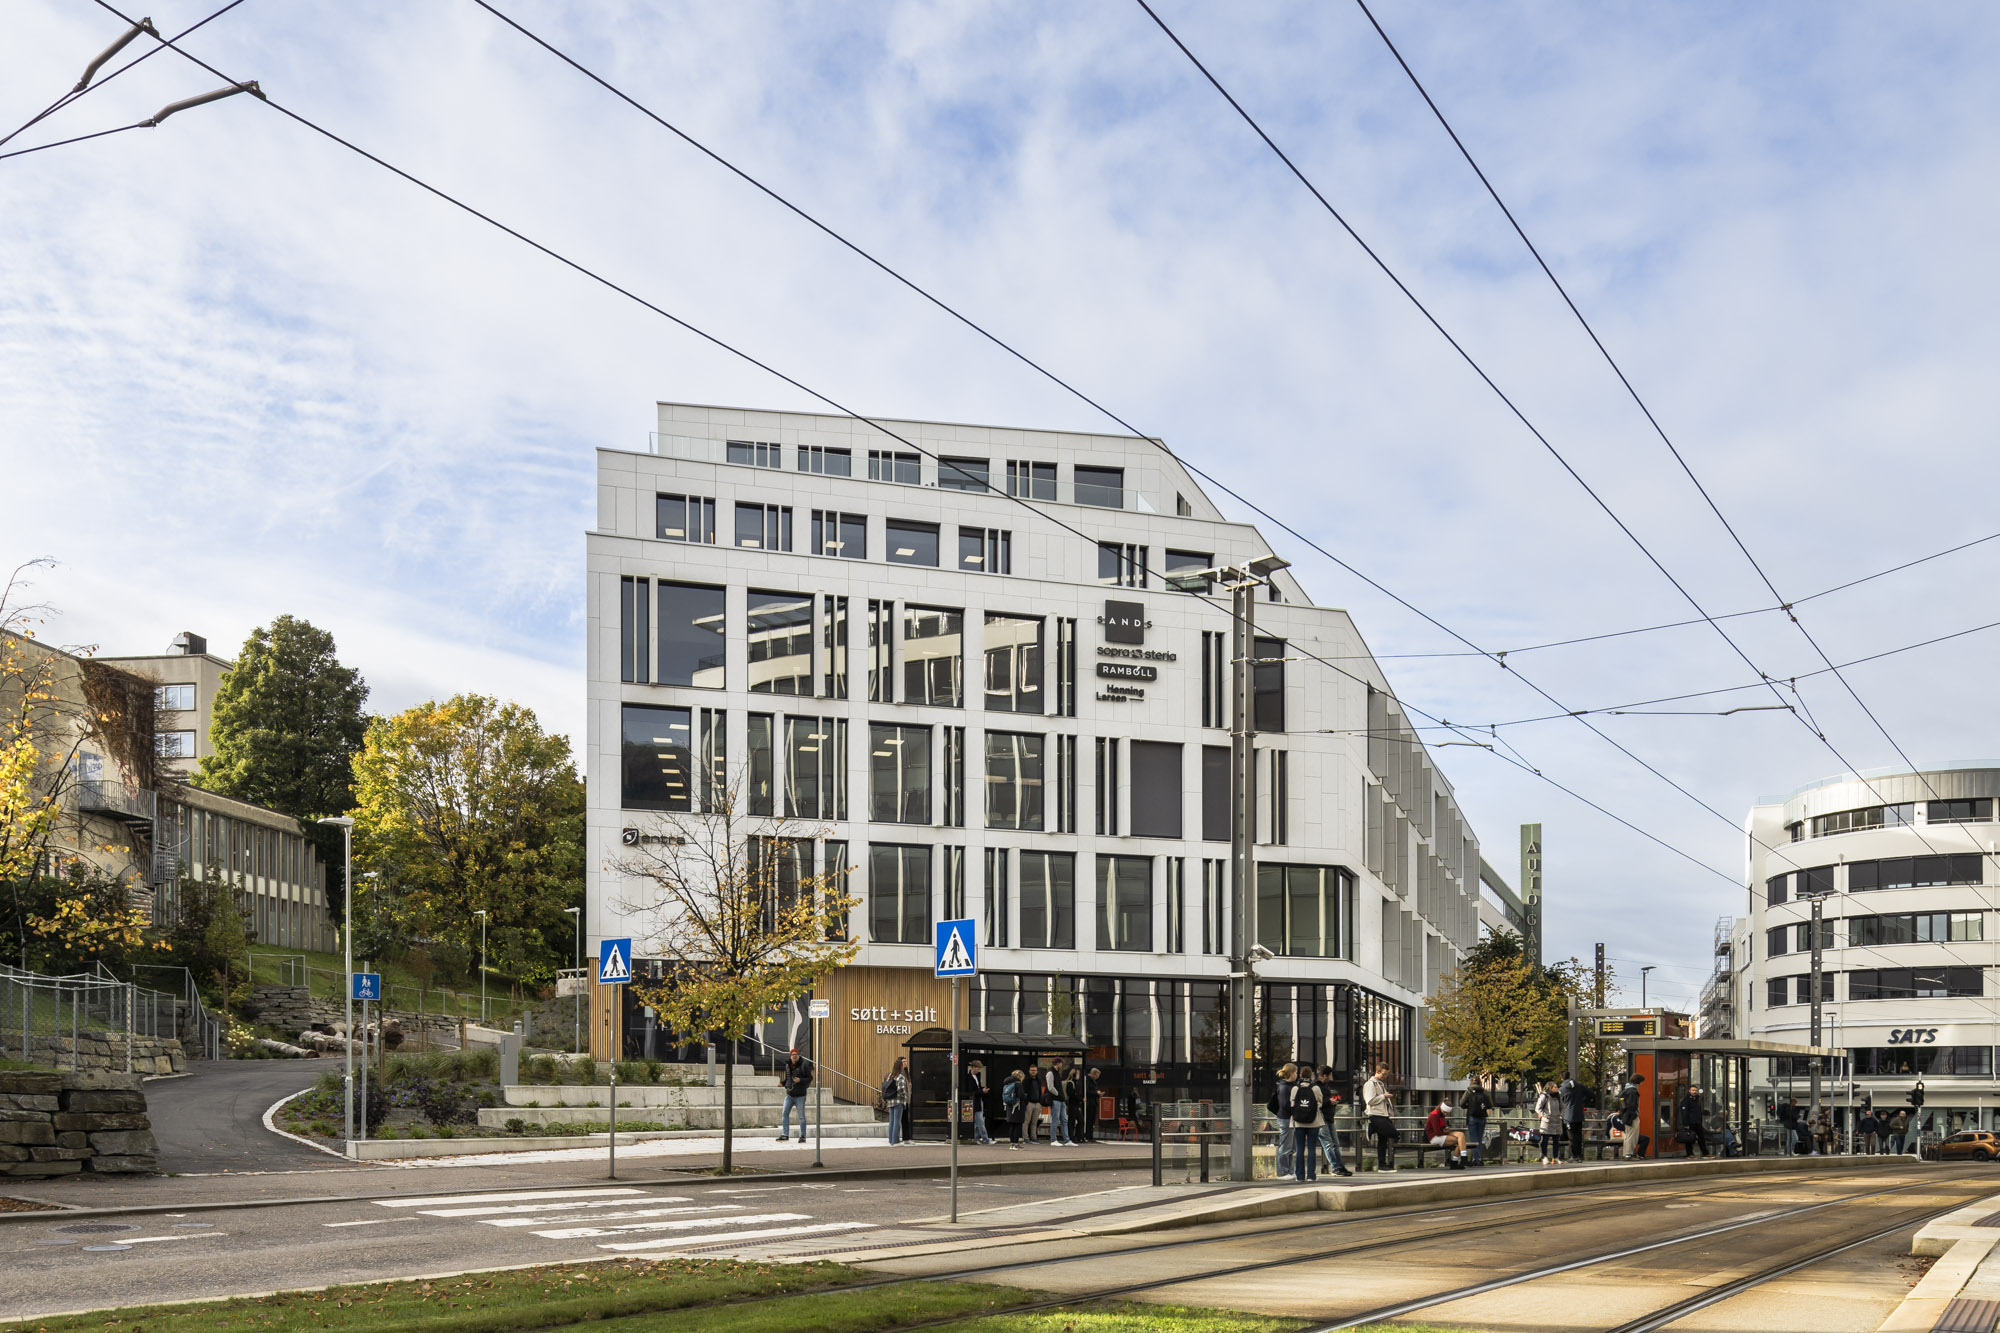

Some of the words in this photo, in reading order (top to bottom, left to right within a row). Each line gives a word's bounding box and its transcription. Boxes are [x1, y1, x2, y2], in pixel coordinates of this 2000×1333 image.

[1097, 615, 1153, 629] SANDS
[1097, 646, 1130, 658] sopra
[1144, 650, 1177, 662] steria
[1096, 691, 1127, 702] Larsen
[1107, 684, 1144, 698] Henning
[850, 1006, 887, 1021] søtt
[904, 1005, 937, 1022] salt
[876, 1024, 911, 1035] BAKERI
[1887, 1028, 1939, 1044] SATS
